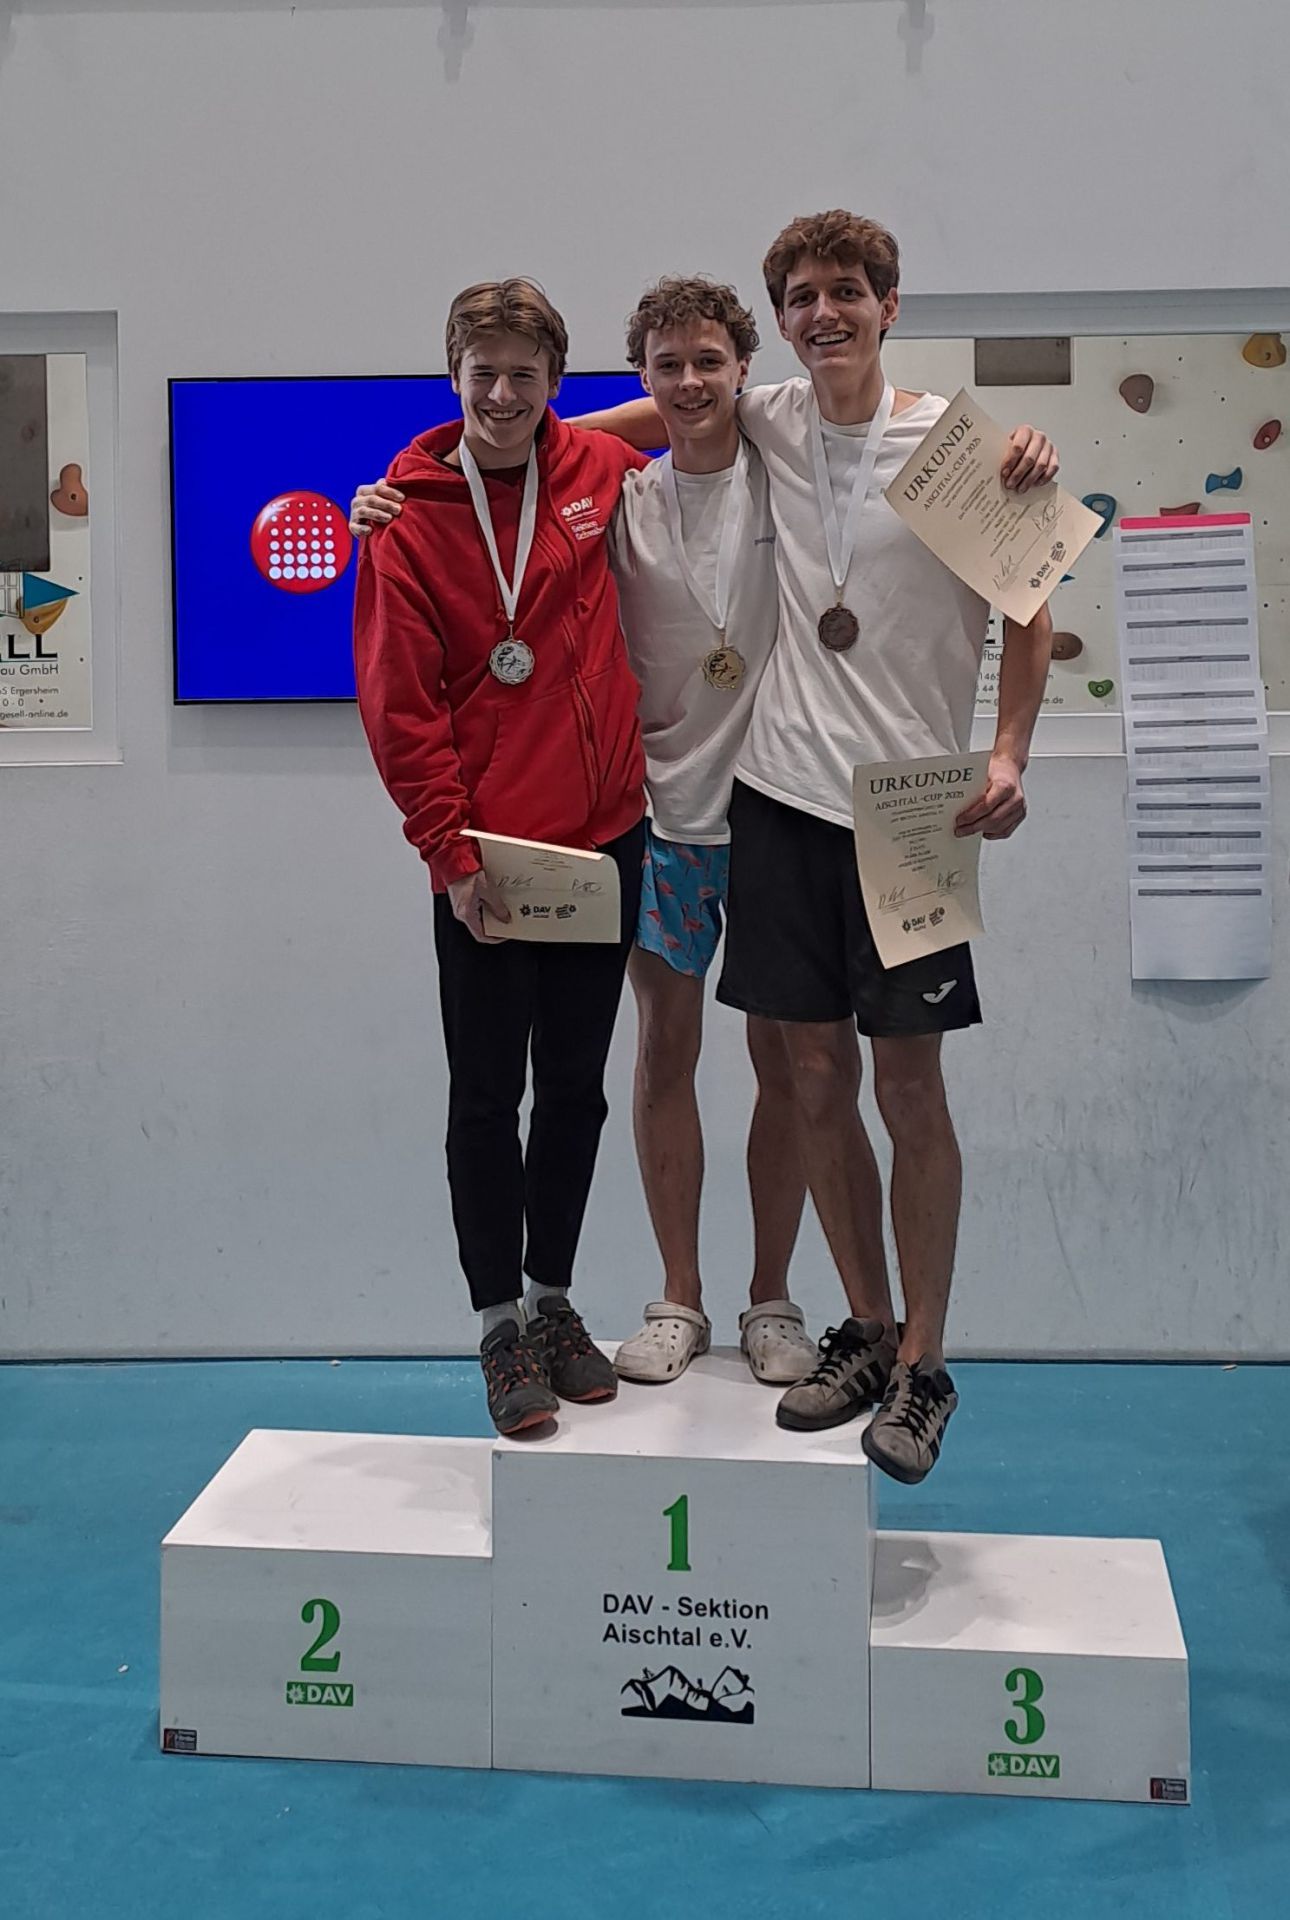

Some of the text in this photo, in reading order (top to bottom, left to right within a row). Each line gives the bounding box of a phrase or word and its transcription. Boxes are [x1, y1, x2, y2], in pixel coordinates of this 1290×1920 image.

[903, 414, 974, 502] URKUNDE
[570, 496, 593, 512] DAV
[0, 633, 58, 659] LL
[20, 664, 59, 676] GmbH
[10, 686, 60, 697] Ergersheim
[870, 768, 974, 795] URKUNDE
[662, 1494, 692, 1572] 1
[602, 1594, 654, 1615] DAV
[677, 1596, 769, 1620] Sektion
[300, 1598, 341, 1672] 2
[602, 1623, 752, 1649] Aischtal e.V.
[307, 1684, 351, 1705] DAV
[1004, 1667, 1046, 1745] 3
[1009, 1755, 1057, 1776] DAV
